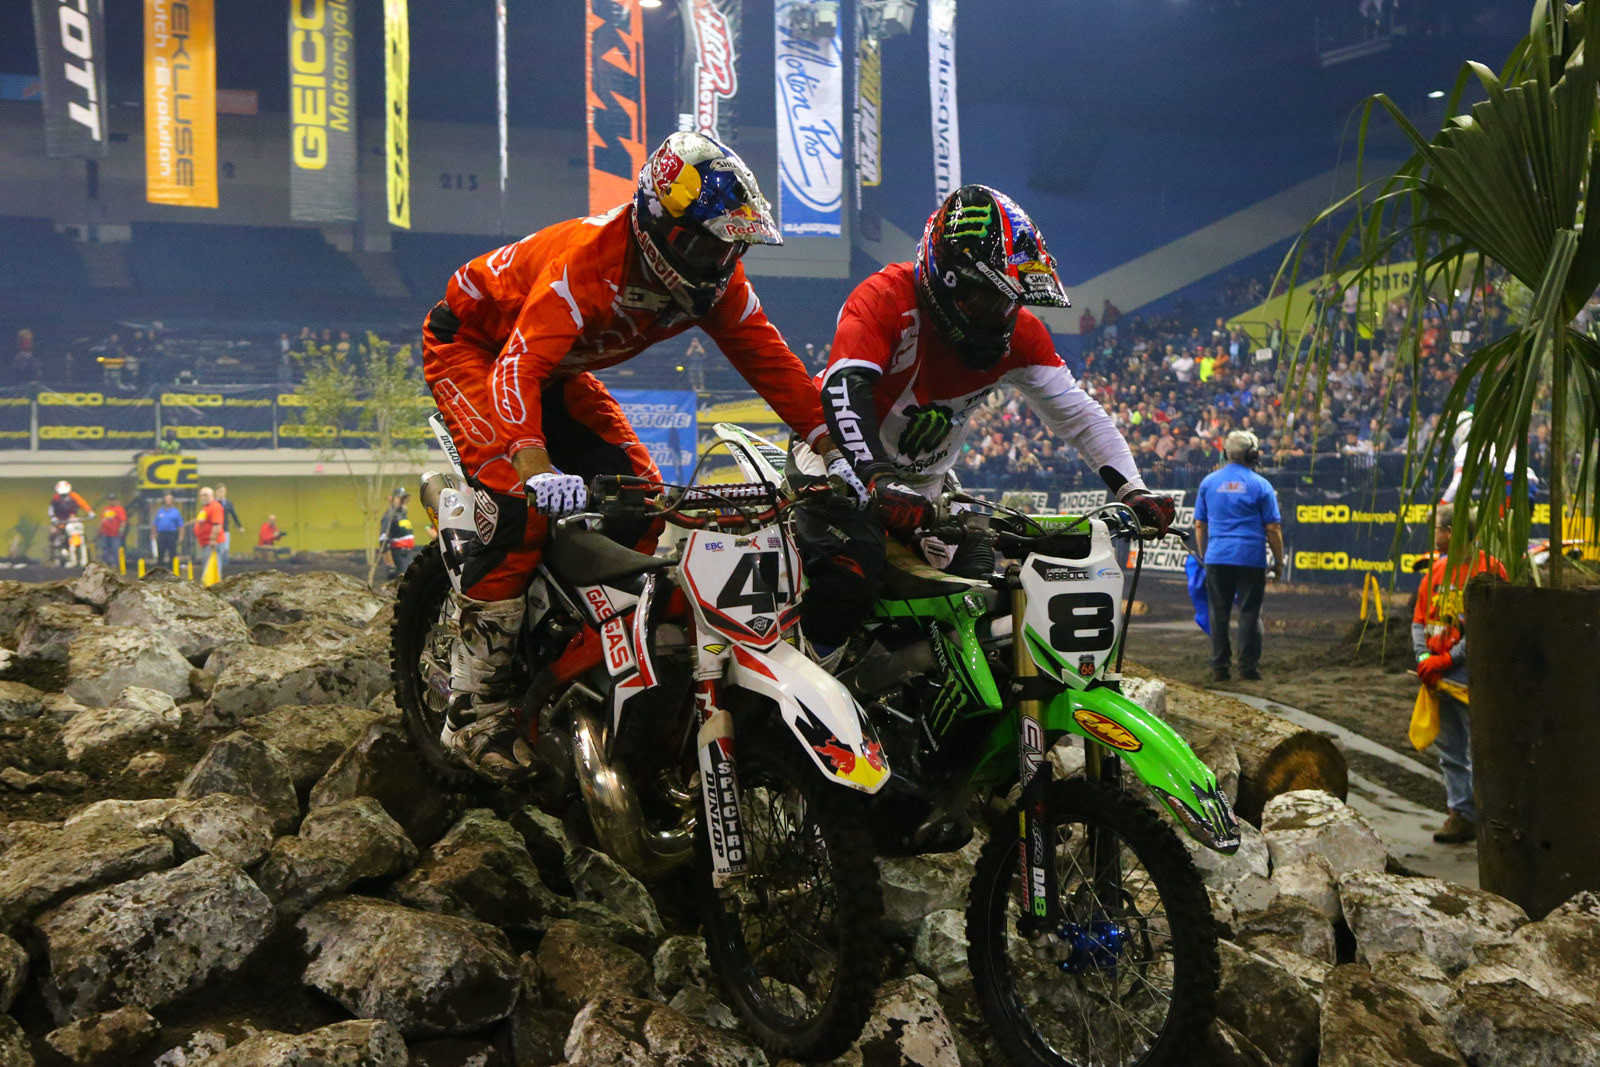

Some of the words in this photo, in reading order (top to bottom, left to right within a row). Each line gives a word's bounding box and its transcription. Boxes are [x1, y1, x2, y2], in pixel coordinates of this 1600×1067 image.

[58, 0, 101, 141] OTT
[171, 0, 194, 186] EKLUSE
[328, 0, 353, 132] Motorcycl
[726, 223, 757, 236] Red
[440, 434, 461, 467] DUNLOP
[827, 377, 874, 468] THOR
[684, 488, 770, 501] RENTHAL
[1297, 504, 1350, 523] GEICO
[705, 541, 724, 551] EBC
[1295, 551, 1349, 570] GEICO
[717, 551, 788, 615] 4
[1047, 592, 1115, 653] 8
[705, 770, 725, 858] DUNLOP
[717, 762, 743, 862] SPECTRO
